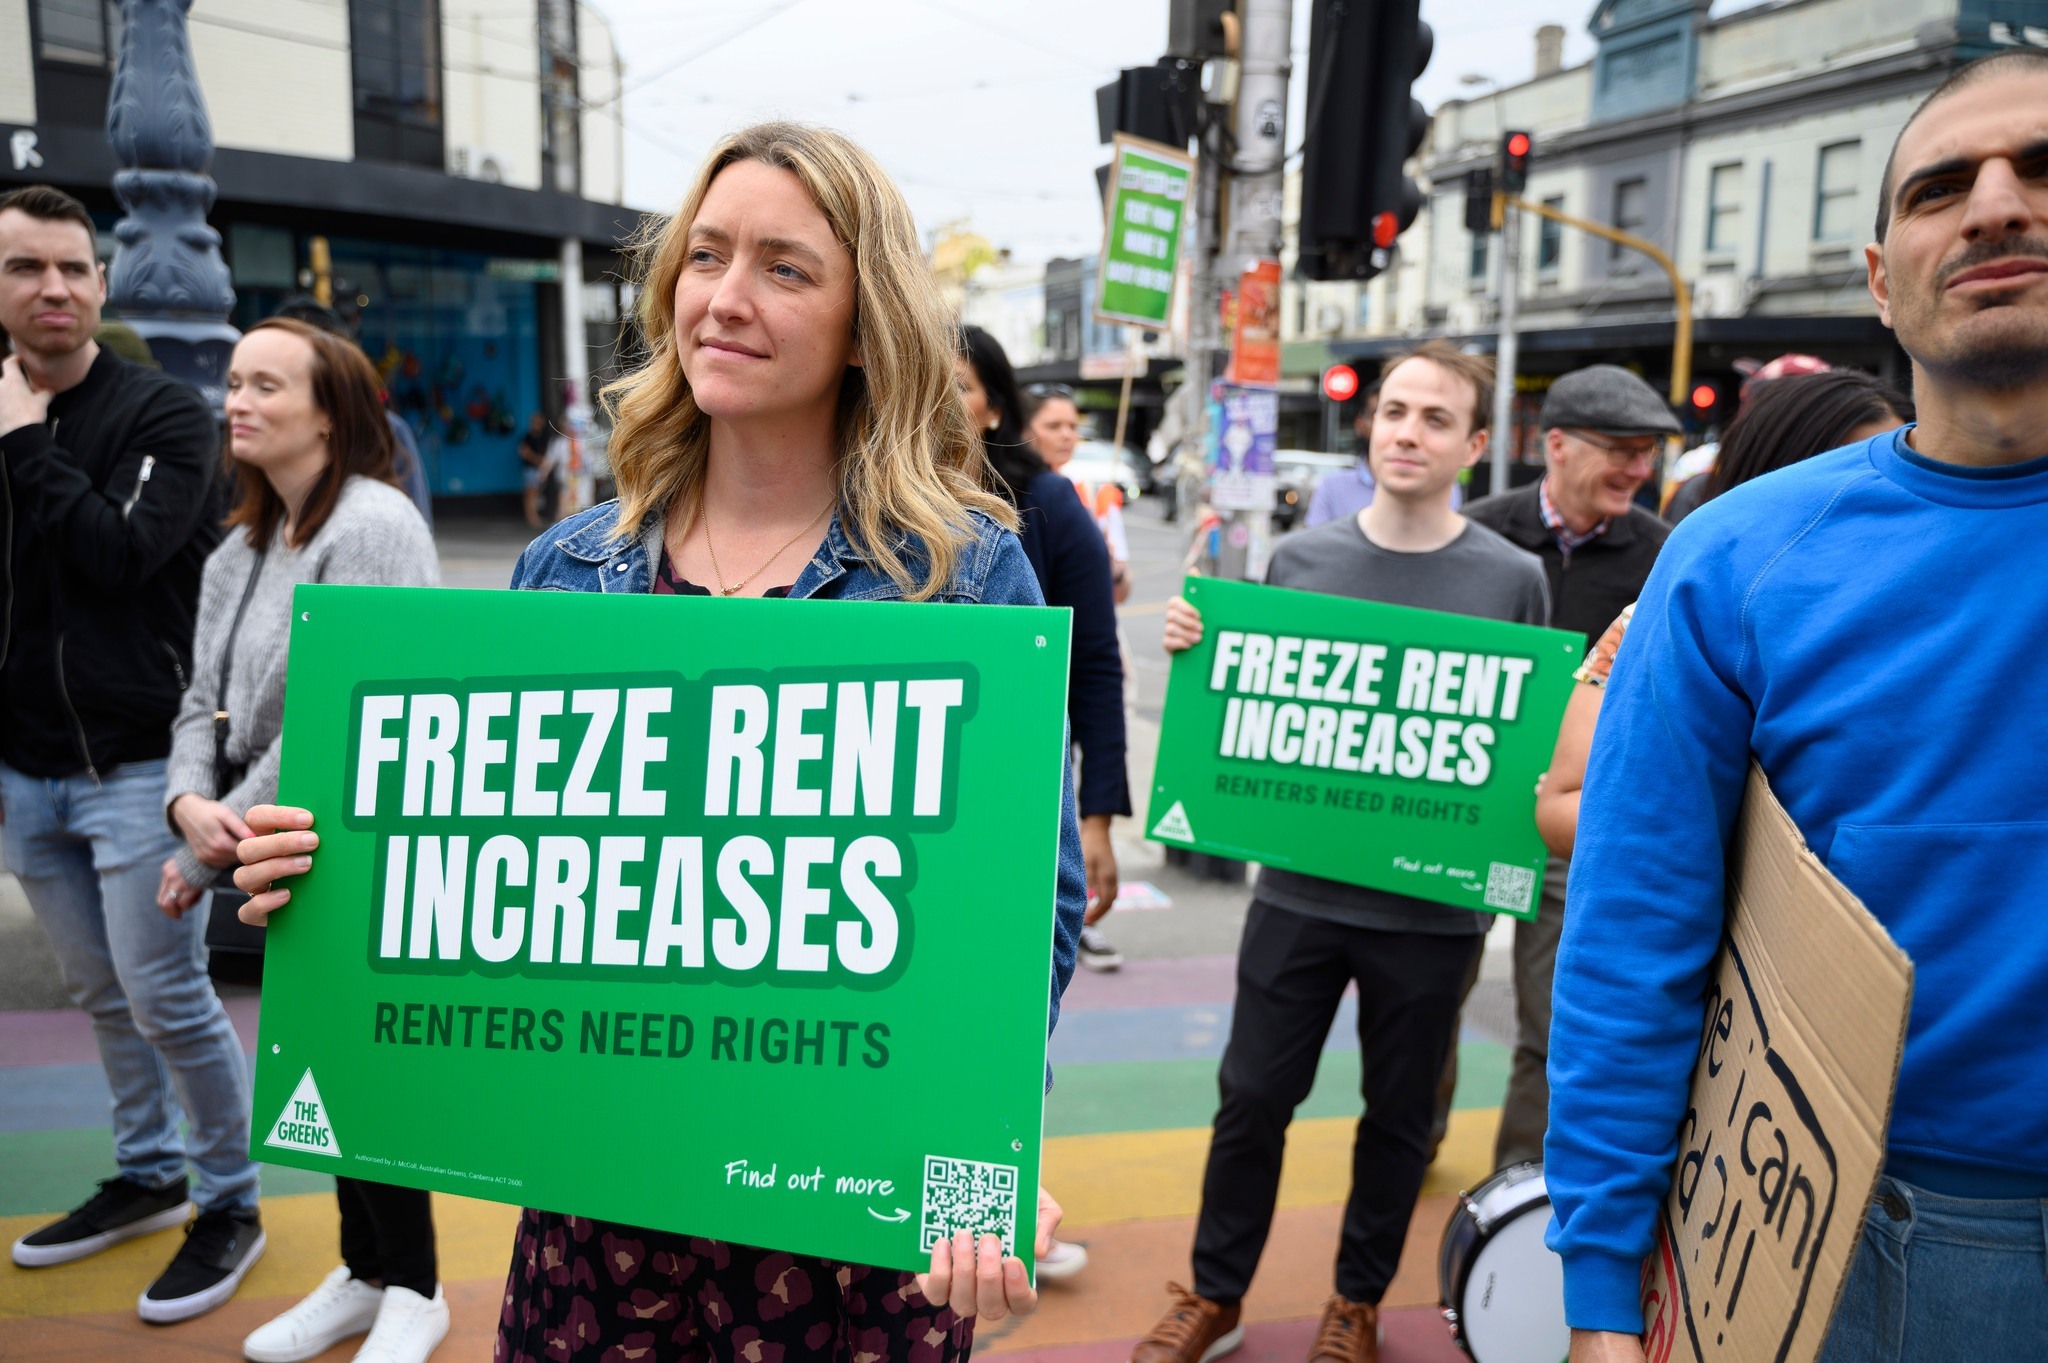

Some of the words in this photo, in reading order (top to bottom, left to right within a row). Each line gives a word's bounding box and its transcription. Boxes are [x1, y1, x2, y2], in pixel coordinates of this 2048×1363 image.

[1211, 630, 1388, 707] FREEZE
[1396, 647, 1533, 721] RENT
[354, 686, 673, 817] FREEZE
[703, 678, 964, 817] RENT
[1219, 697, 1495, 786] INCREASES
[1215, 773, 1317, 806] RENTERS
[1323, 786, 1384, 813] NEED
[1391, 795, 1481, 826] RIGHTS
[380, 834, 902, 975] INCREASES
[374, 1001, 565, 1053] RENTERS
[579, 1010, 695, 1059] NEED
[711, 1015, 892, 1069] RIGHTS
[277, 1120, 330, 1148] GREENS
[294, 1100, 319, 1123] THE
[354, 1153, 384, 1164] Authorised
[384, 1158, 391, 1167] by
[419, 1164, 447, 1174] Australian
[447, 1168, 468, 1178] Greens,
[468, 1171, 494, 1182] Canberra
[494, 1176, 507, 1184] ACT
[725, 1159, 777, 1188] Find
[787, 1165, 825, 1192] out
[835, 1175, 896, 1197] more
[1740, 1101, 1815, 1270] can
